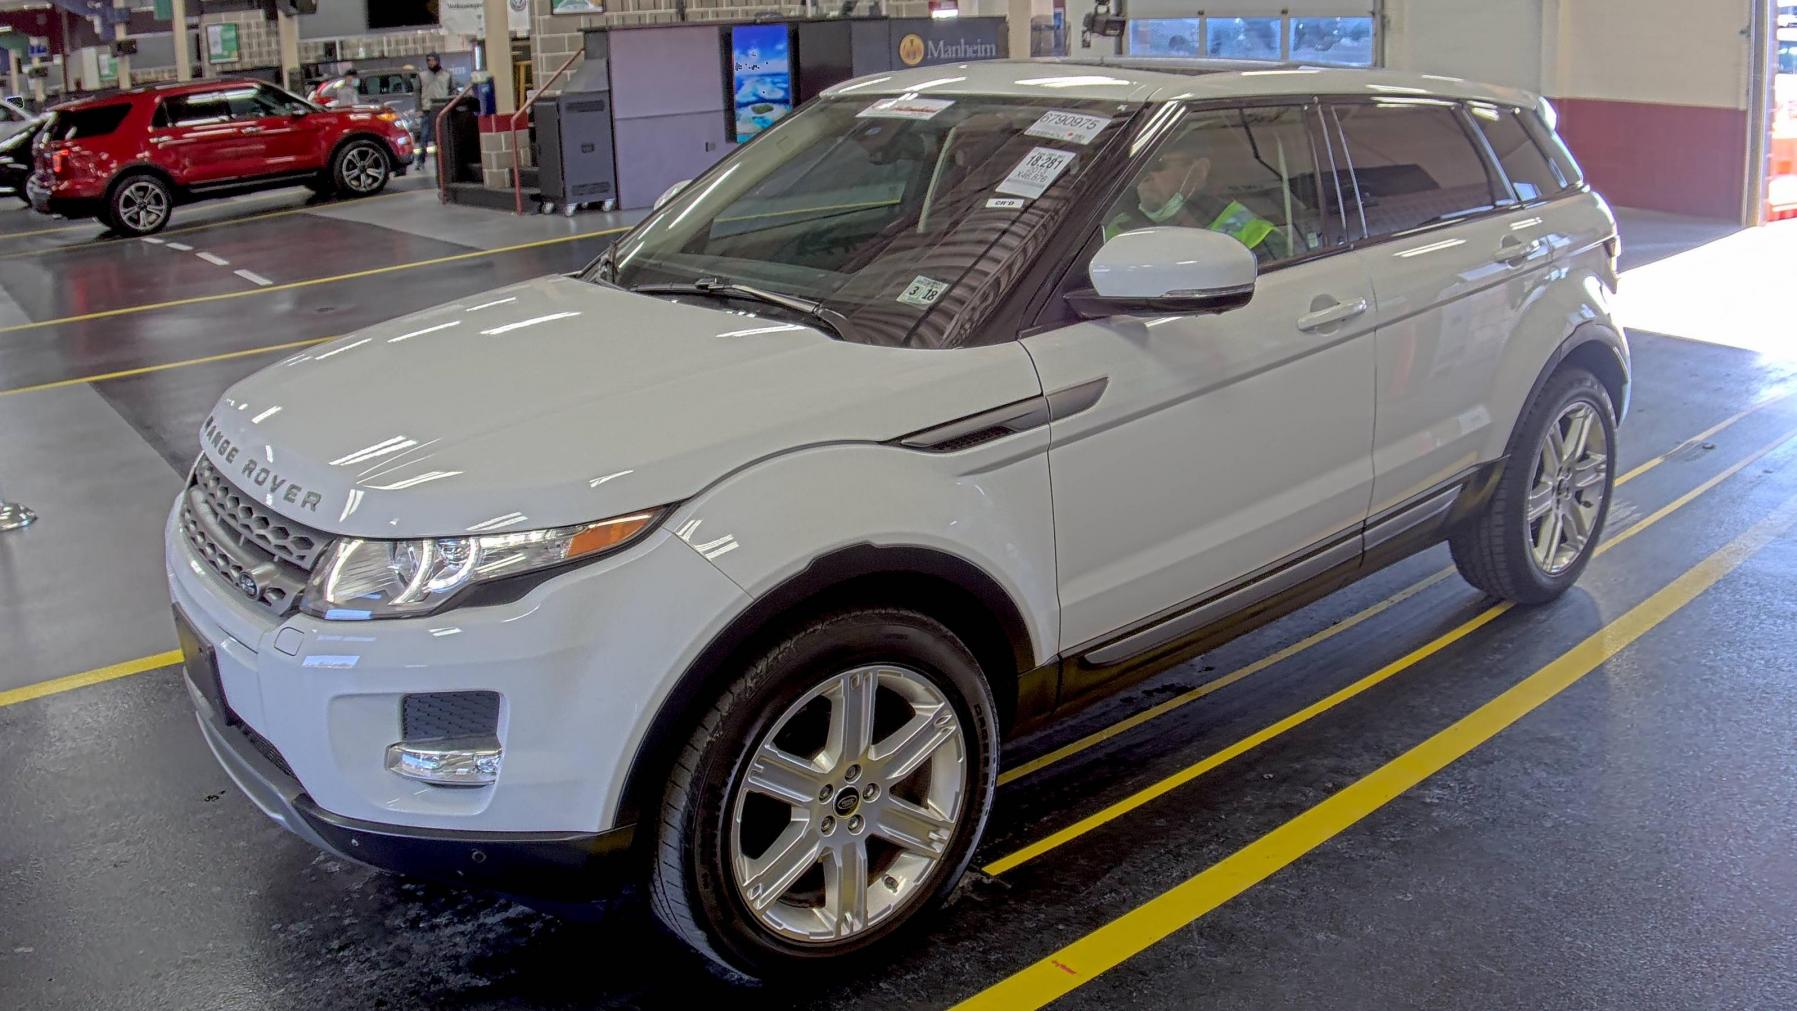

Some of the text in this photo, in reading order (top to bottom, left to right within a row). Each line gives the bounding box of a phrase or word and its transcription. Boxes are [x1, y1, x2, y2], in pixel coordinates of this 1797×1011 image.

[926, 38, 997, 59] Manheim
[1041, 112, 1097, 130] 6790975
[909, 286, 938, 301] 3 18
[203, 415, 322, 512] RANGE ROVER
